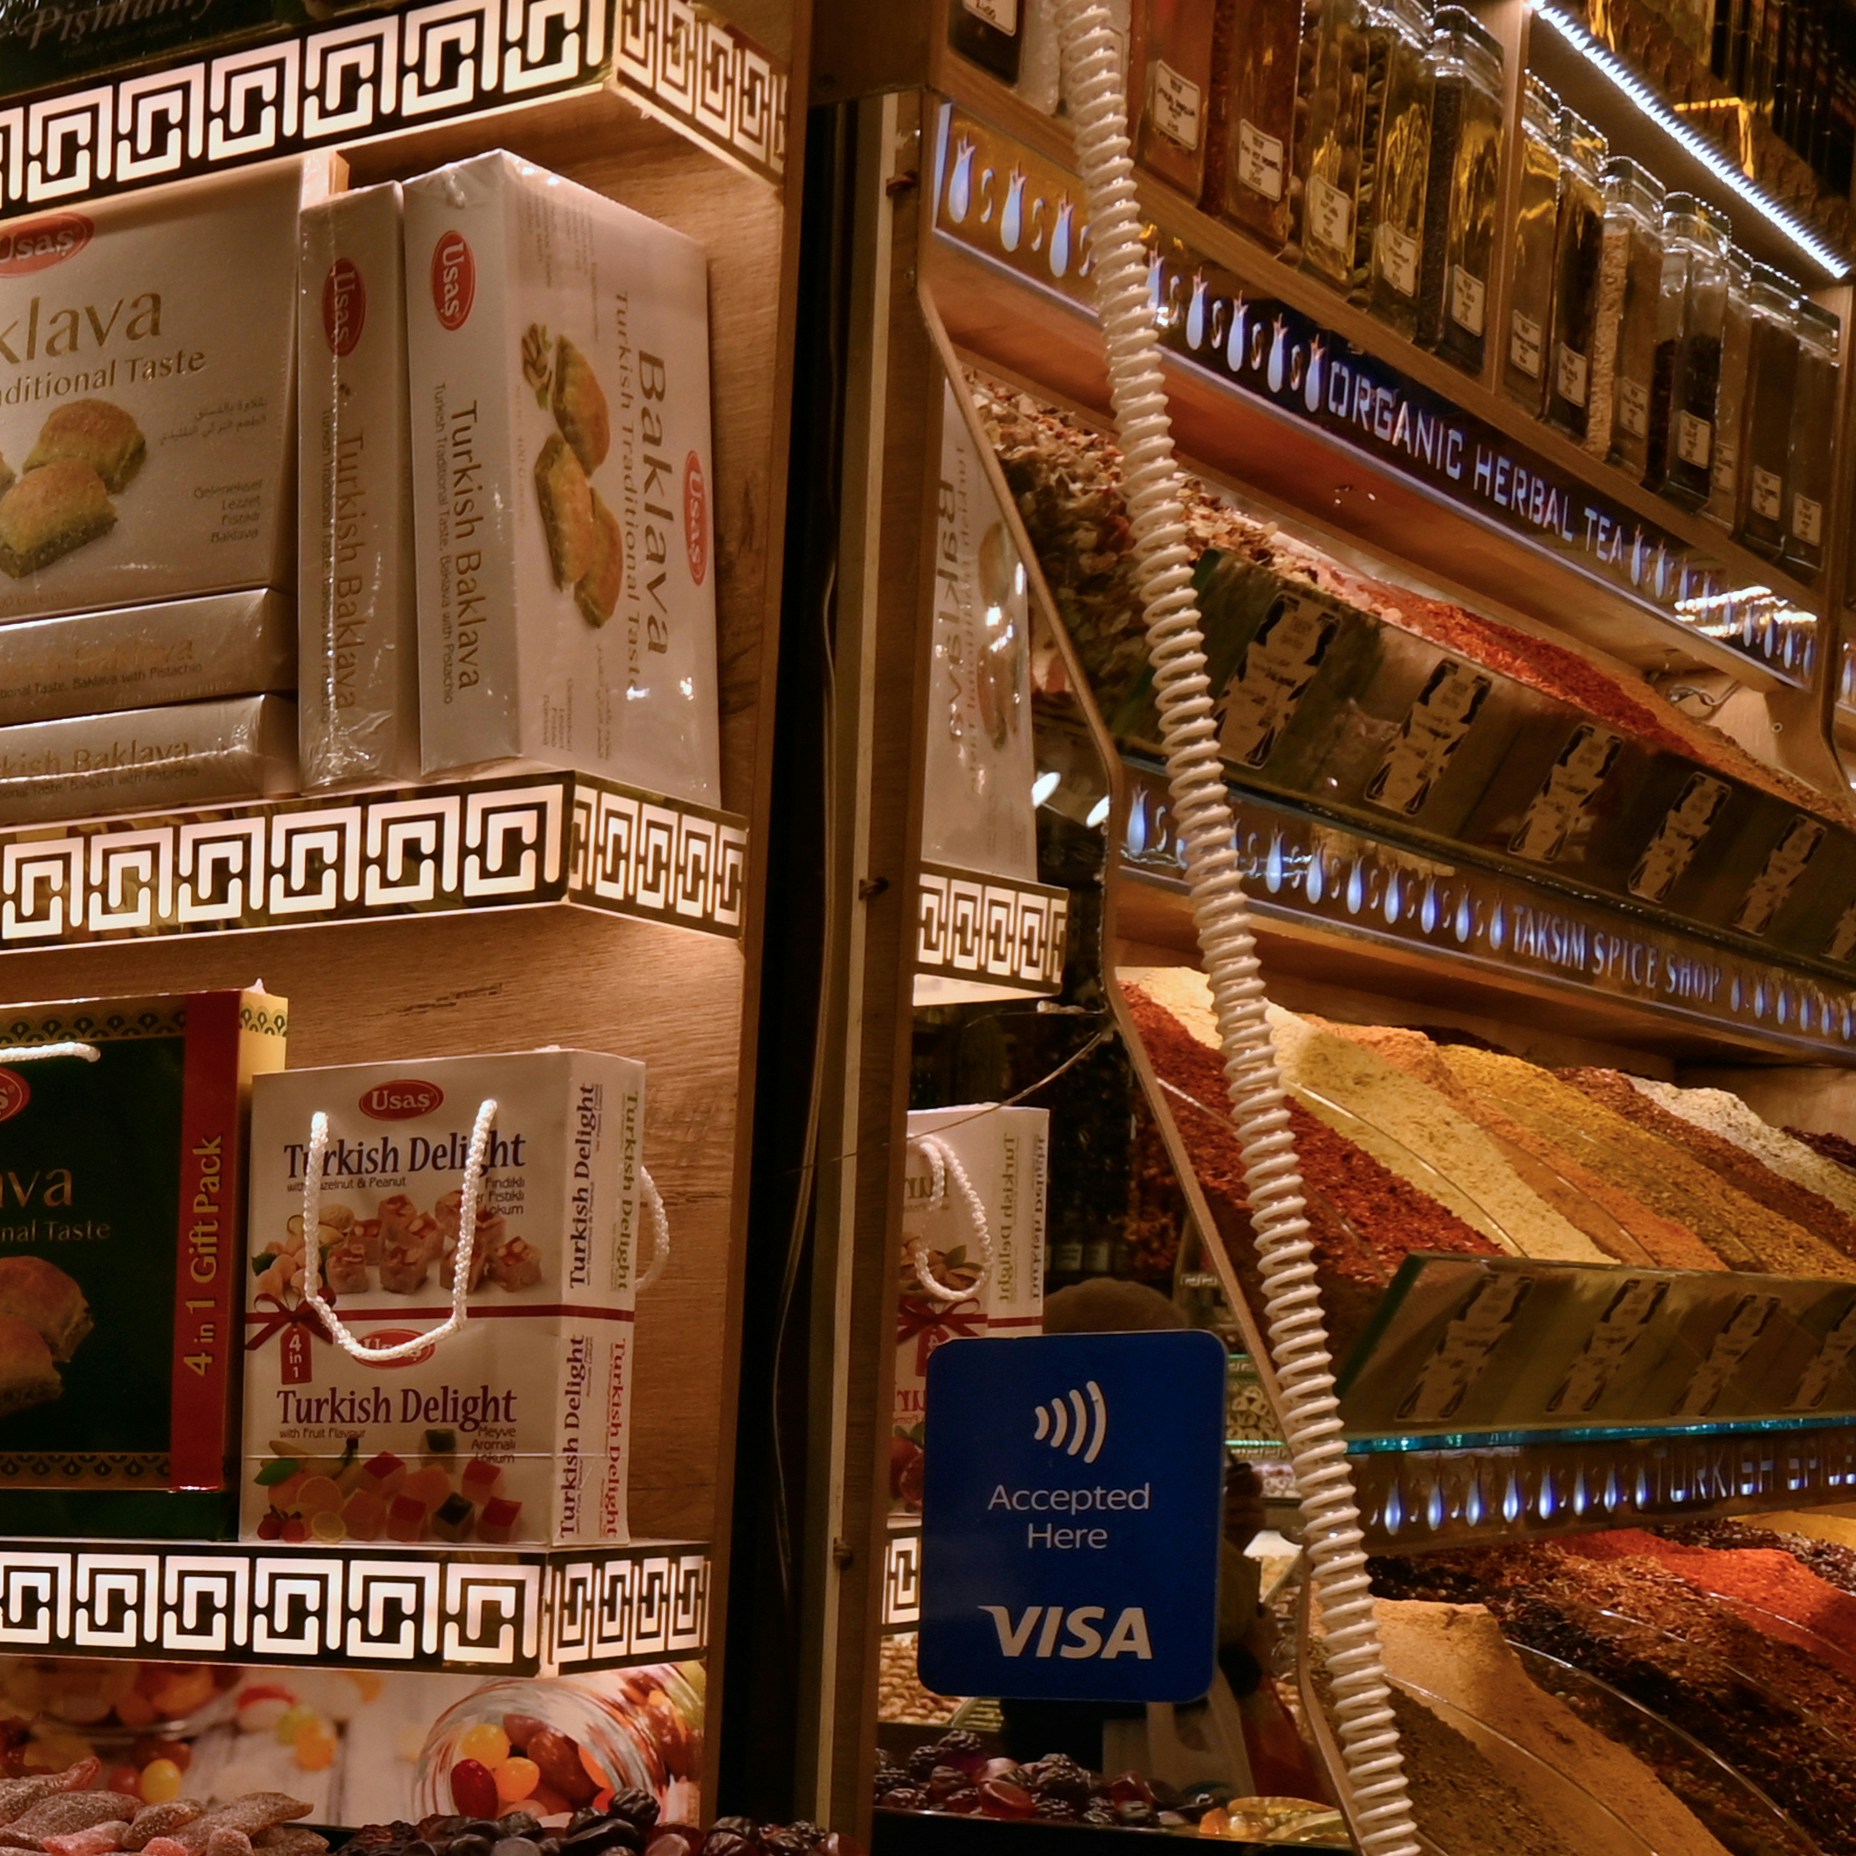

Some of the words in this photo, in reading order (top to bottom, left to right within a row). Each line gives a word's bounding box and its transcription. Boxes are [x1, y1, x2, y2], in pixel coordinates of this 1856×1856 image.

[440, 241, 465, 318] Usaş
[125, 347, 206, 384] Taste
[450, 398, 484, 540] Turkish
[637, 347, 675, 656] Baklava
[1328, 360, 1464, 481] ORGANIC
[1473, 443, 1575, 544] HERBAL
[1584, 506, 1624, 570] TEA
[455, 550, 487, 691] Baklava
[1513, 904, 1587, 971] TAKSIM
[1591, 931, 1659, 989] SPICE
[1665, 952, 1722, 1004] SHOP
[371, 1089, 432, 1112] Usaş
[573, 1082, 595, 1179] Delight
[621, 1091, 638, 1192] Turkish
[192, 1133, 222, 1226] Pack
[368, 1176, 407, 1190] Peanut
[44, 1218, 111, 1244] Taste
[190, 1233, 220, 1288] Gift
[569, 1184, 589, 1289] Turkish
[289, 1334, 302, 1352] 4
[289, 1353, 302, 1365] in
[564, 1334, 586, 1431] Delight
[277, 1385, 392, 1425] Turkish
[400, 1385, 518, 1432] Delight
[609, 1337, 627, 1438] Turkish
[279, 1428, 300, 1439] with
[302, 1427, 326, 1439] Fruit
[559, 1437, 580, 1539] Turkish
[603, 1443, 623, 1538] Delight
[987, 1481, 1152, 1515] Accepted
[1026, 1522, 1109, 1550] Here
[976, 1605, 1153, 1660] VISA
